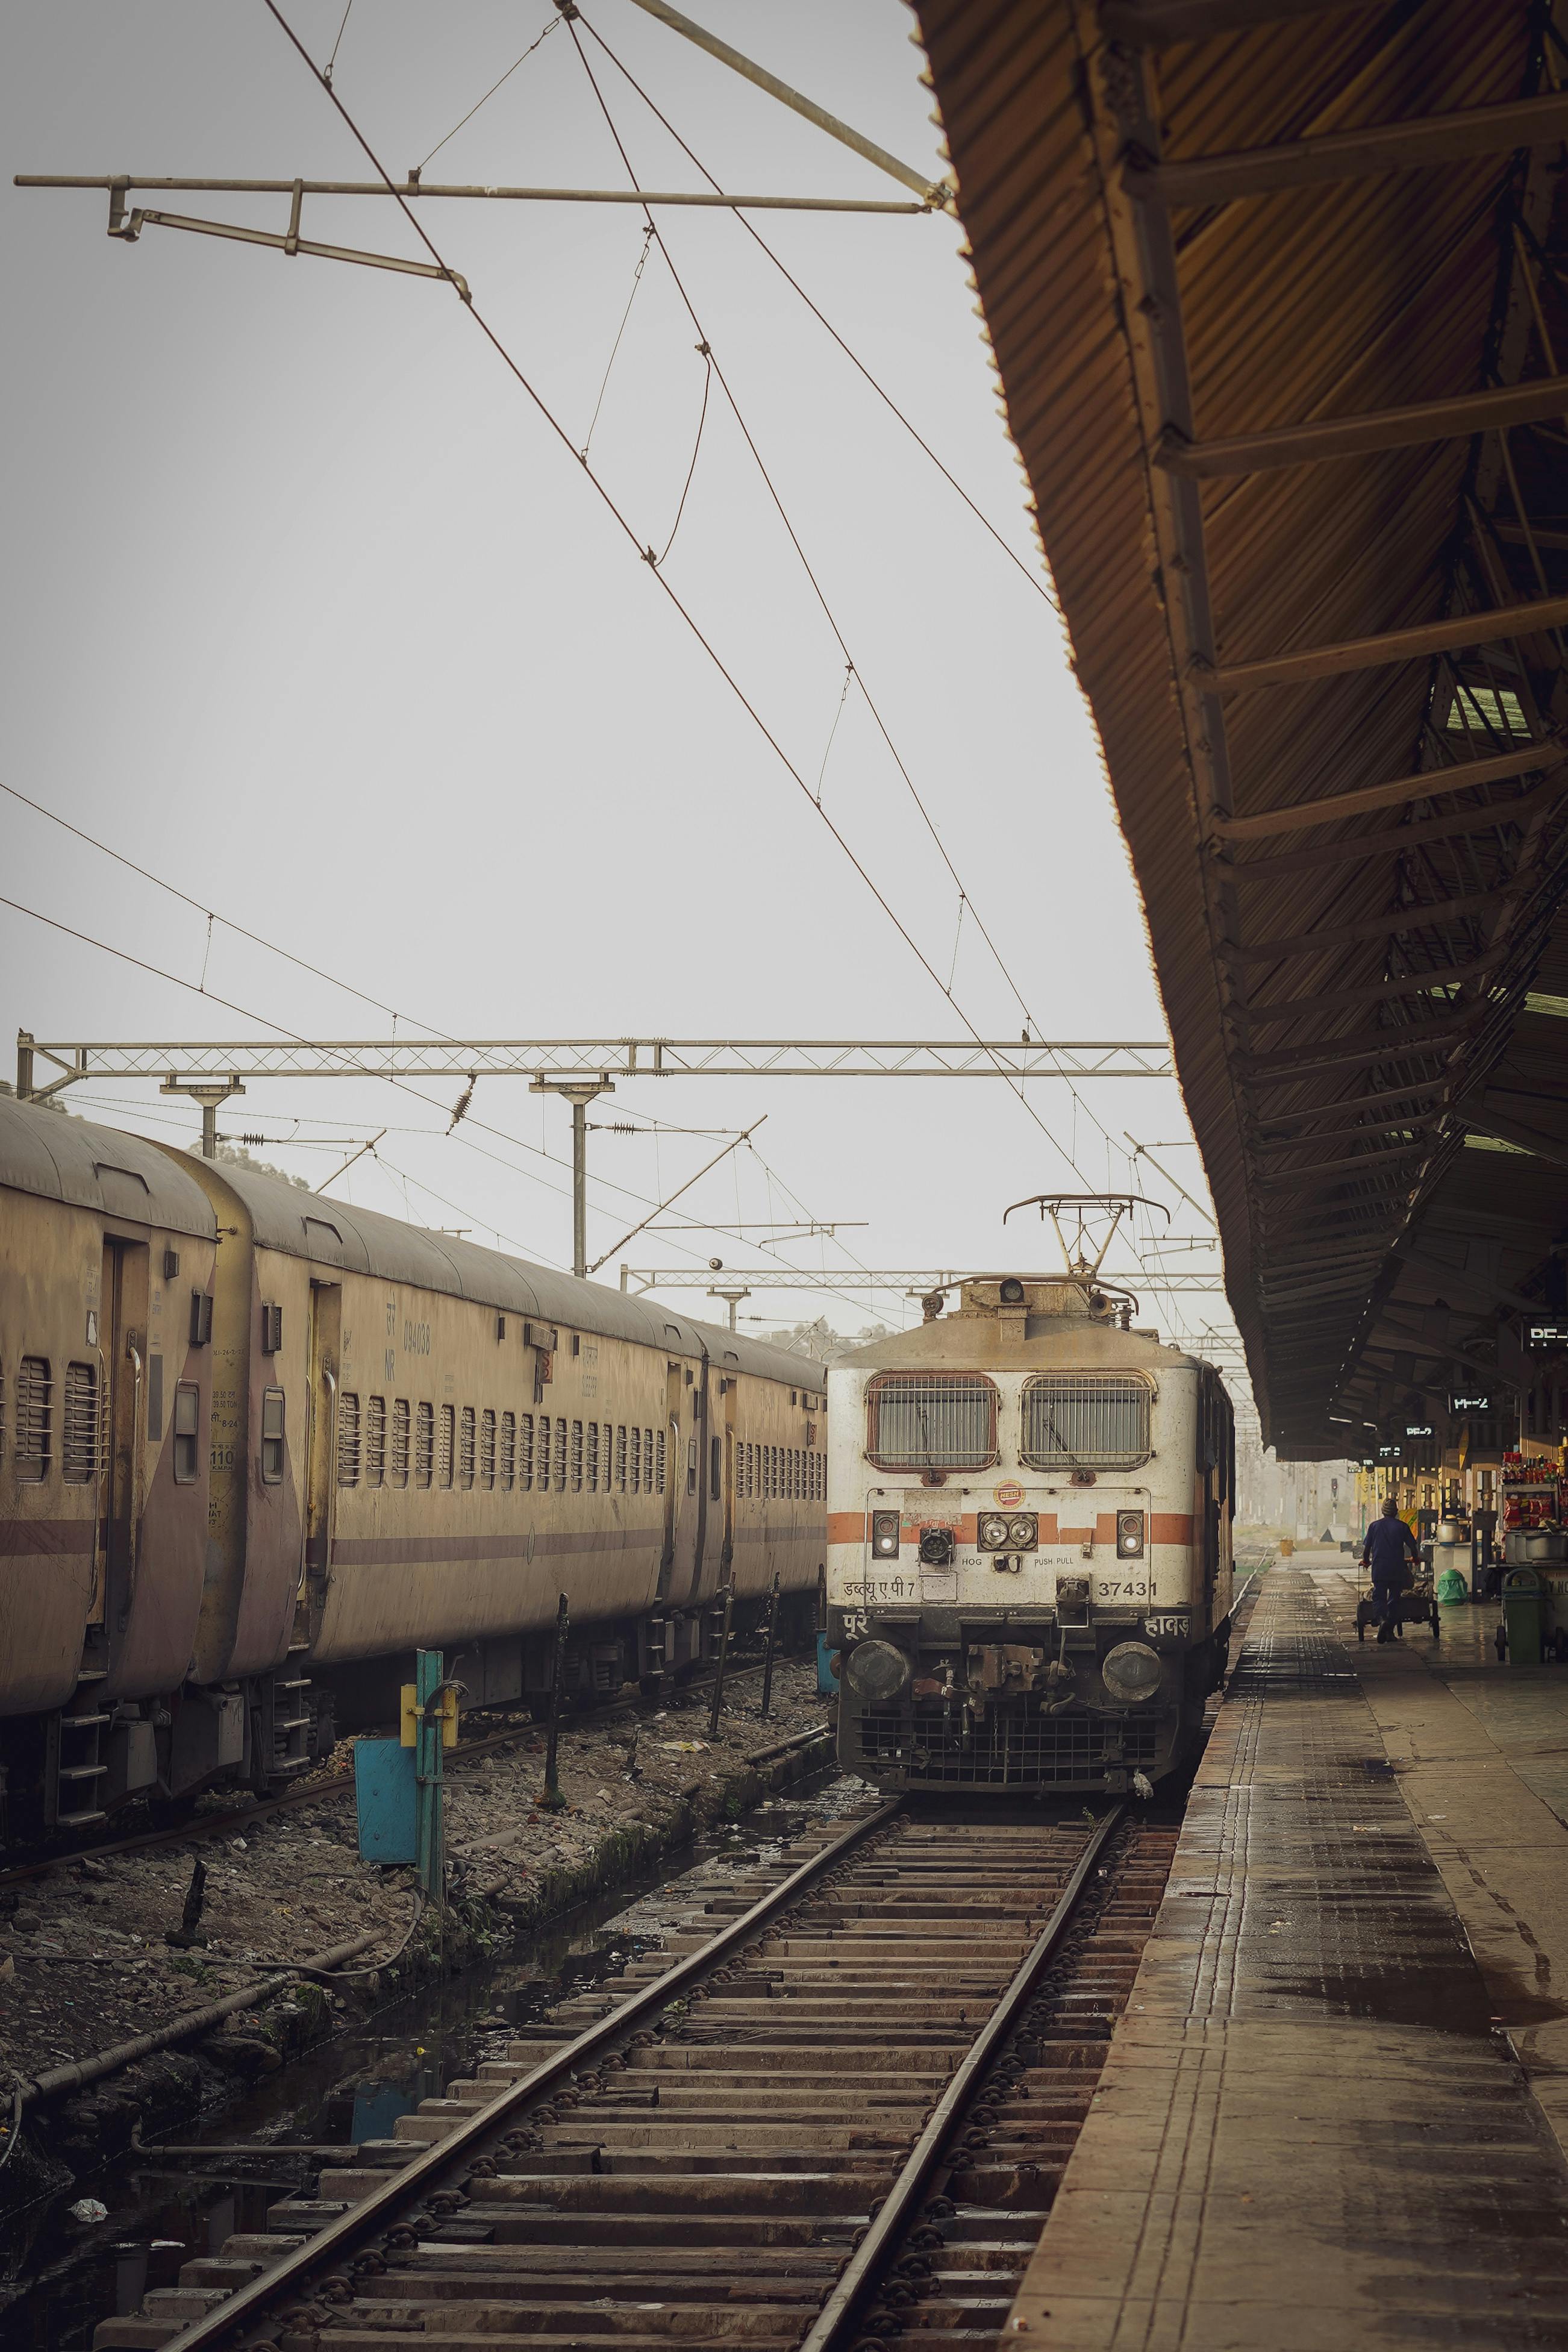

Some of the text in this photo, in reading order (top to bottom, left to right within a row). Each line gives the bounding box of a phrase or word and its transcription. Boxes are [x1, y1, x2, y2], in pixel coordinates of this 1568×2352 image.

[404, 1319, 430, 1356] 094038
[385, 1348, 395, 1382] NR
[211, 1450, 234, 1465] 110
[1034, 1558, 1053, 1566] PUSH
[908, 1583, 915, 1597] 7
[1099, 1582, 1157, 1597] 37431
